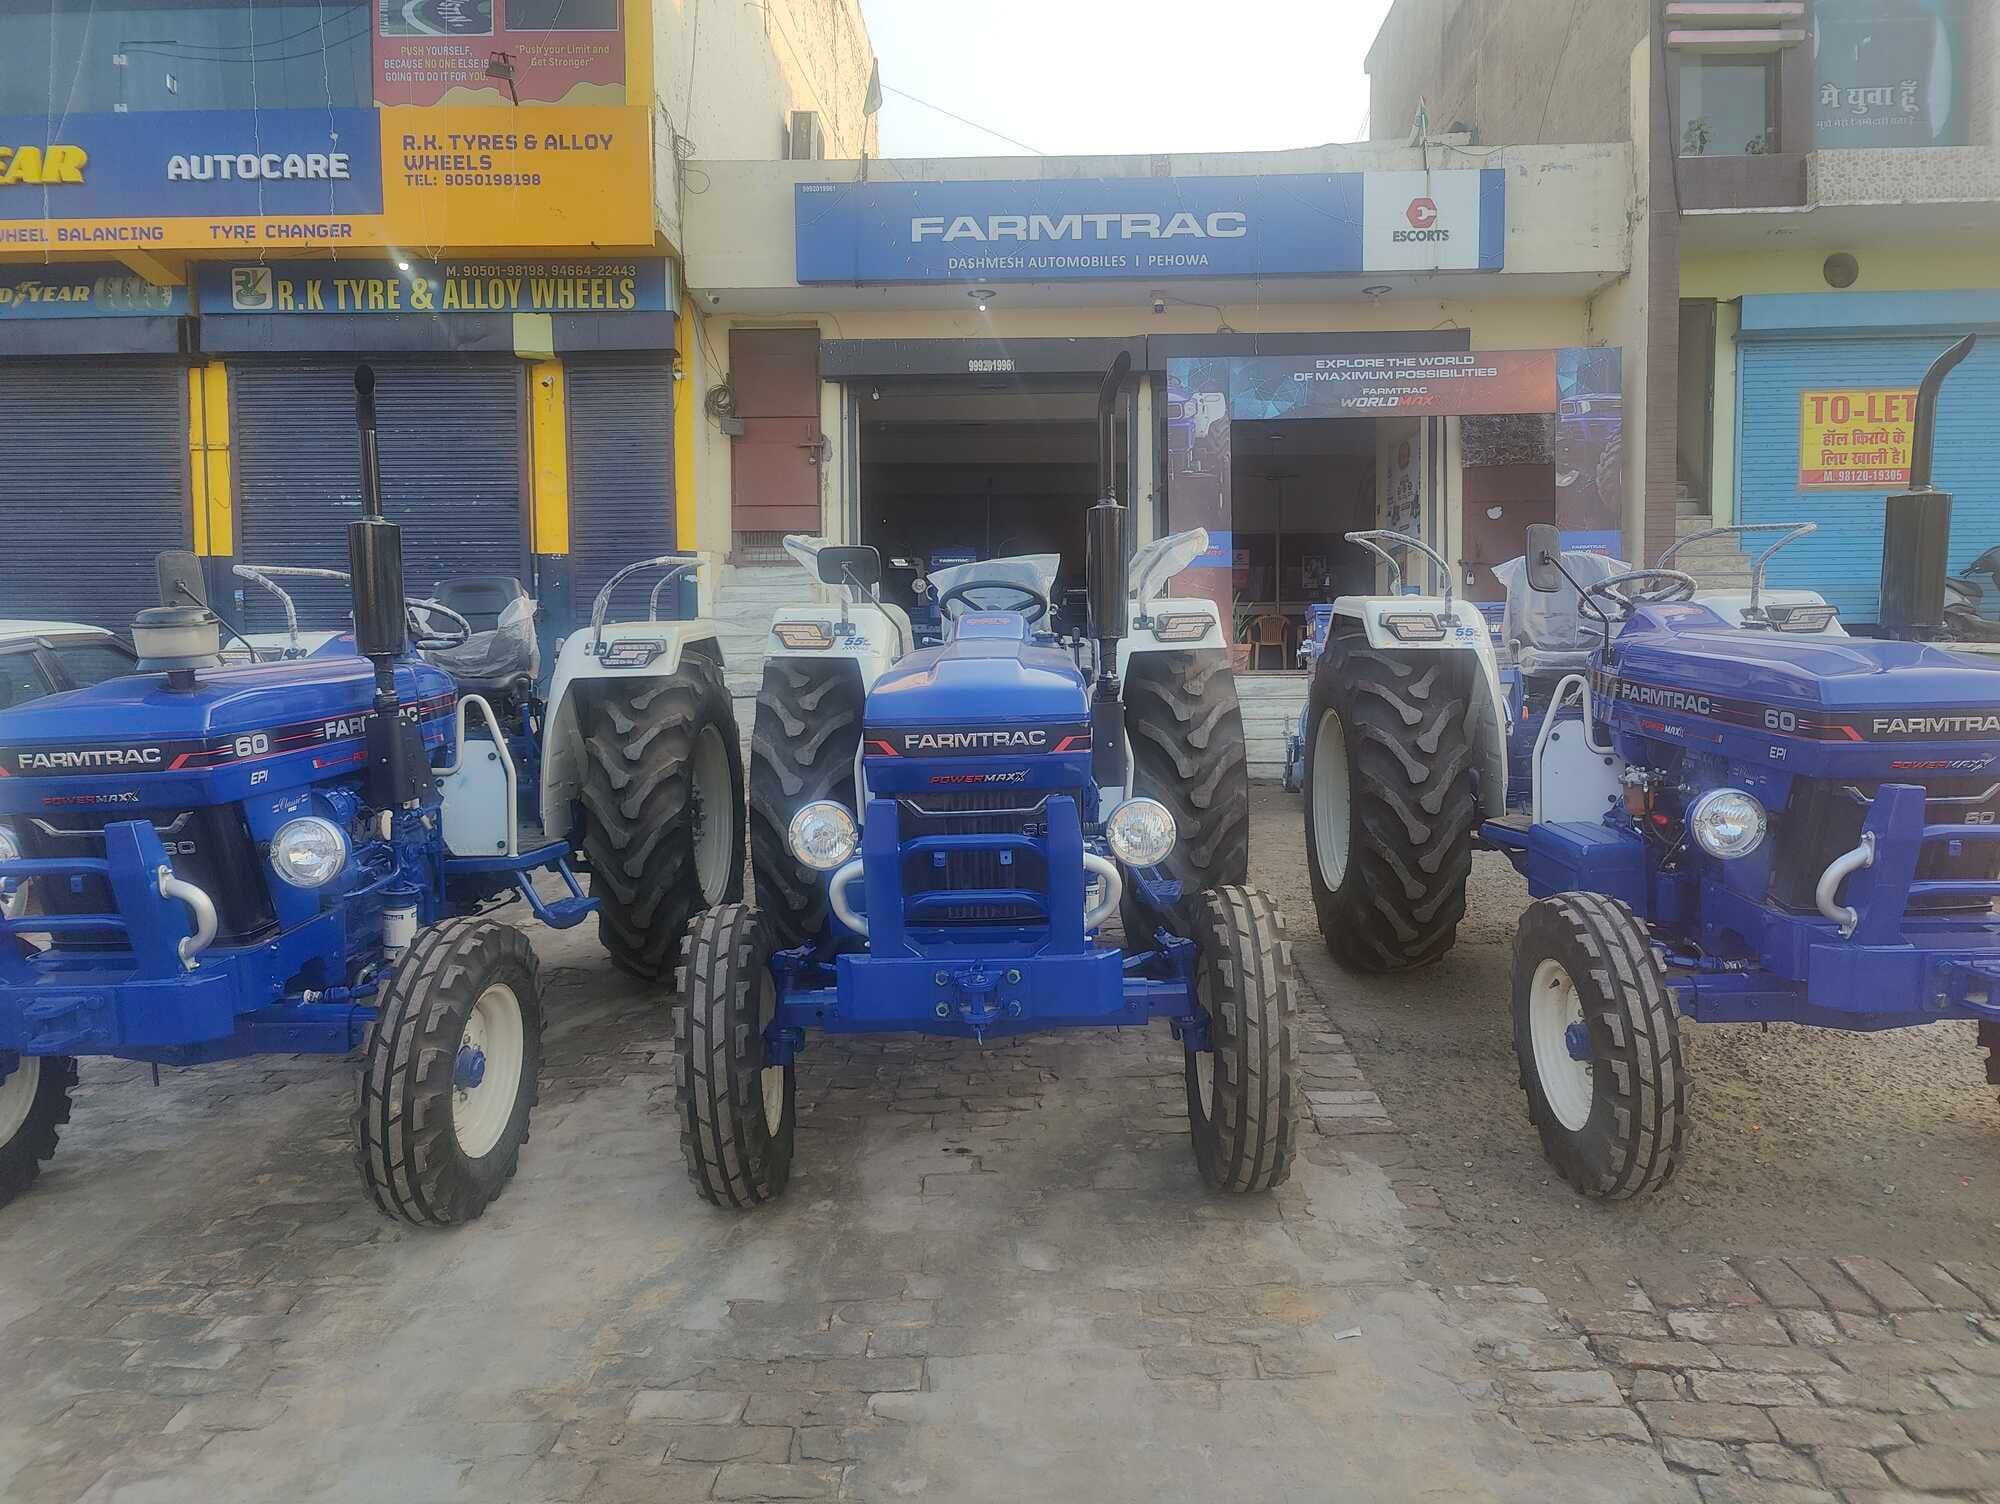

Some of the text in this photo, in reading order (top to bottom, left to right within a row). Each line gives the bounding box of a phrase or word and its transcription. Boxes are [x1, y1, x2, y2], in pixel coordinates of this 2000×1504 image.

[401, 46, 473, 57] PUSH YOURSELF,
[543, 45, 565, 56] your
[567, 44, 591, 54] Limit
[592, 44, 610, 54] and
[384, 59, 423, 69] BECAUSE
[425, 59, 437, 69] NO
[439, 59, 456, 69] ONE
[458, 59, 480, 69] ELSE
[385, 72, 412, 81] GOING
[415, 72, 425, 81] TO
[426, 72, 439, 81] DO
[440, 72, 449, 81] IT
[450, 72, 467, 81] FOR
[402, 133, 613, 151] R.K. TYRES & ALLOY
[167, 152, 350, 181] AUTOCARE
[403, 154, 492, 171] WHEELS
[404, 173, 541, 186] TEL: 9050198198
[57, 226, 164, 241] BALANCING
[210, 223, 352, 239] TYRE CHANGER
[911, 211, 1247, 242] FARMTRAC
[1392, 230, 1449, 242] ESCORTS
[948, 255, 1024, 270] DASHMESH
[1028, 254, 1127, 269] AUTOMOBILES
[1148, 253, 1209, 267] PEHOWA
[551, 265, 637, 277] 94664-22443
[278, 279, 324, 310] R.K
[333, 279, 400, 310] TYRE
[410, 278, 434, 309] &
[443, 278, 521, 309] ALLOY
[530, 278, 635, 309] WHEELS
[1316, 356, 1474, 369] EXPLORE THE WORLD
[1294, 368, 1498, 381] OF MAXIMUM POSSIBILITIES
[1362, 386, 1428, 395] FARMTRAC
[1811, 394, 1918, 424] TO-LET
[1822, 427, 1905, 446] हॉल किराये के
[1820, 449, 1848, 466] लिए
[1852, 448, 1889, 465] खाली
[1455, 627, 1473, 636] 55
[1622, 683, 1711, 715] FARMTRAC
[1764, 709, 1796, 732] 60
[1873, 716, 2000, 734] FARMTRA
[235, 733, 269, 757] 60
[904, 730, 1047, 749] FARMTRAC
[18, 748, 161, 769] FARMTRAC
[1769, 745, 1787, 761] EPI
[250, 769, 269, 786] EPI
[1965, 811, 1995, 824] 60
